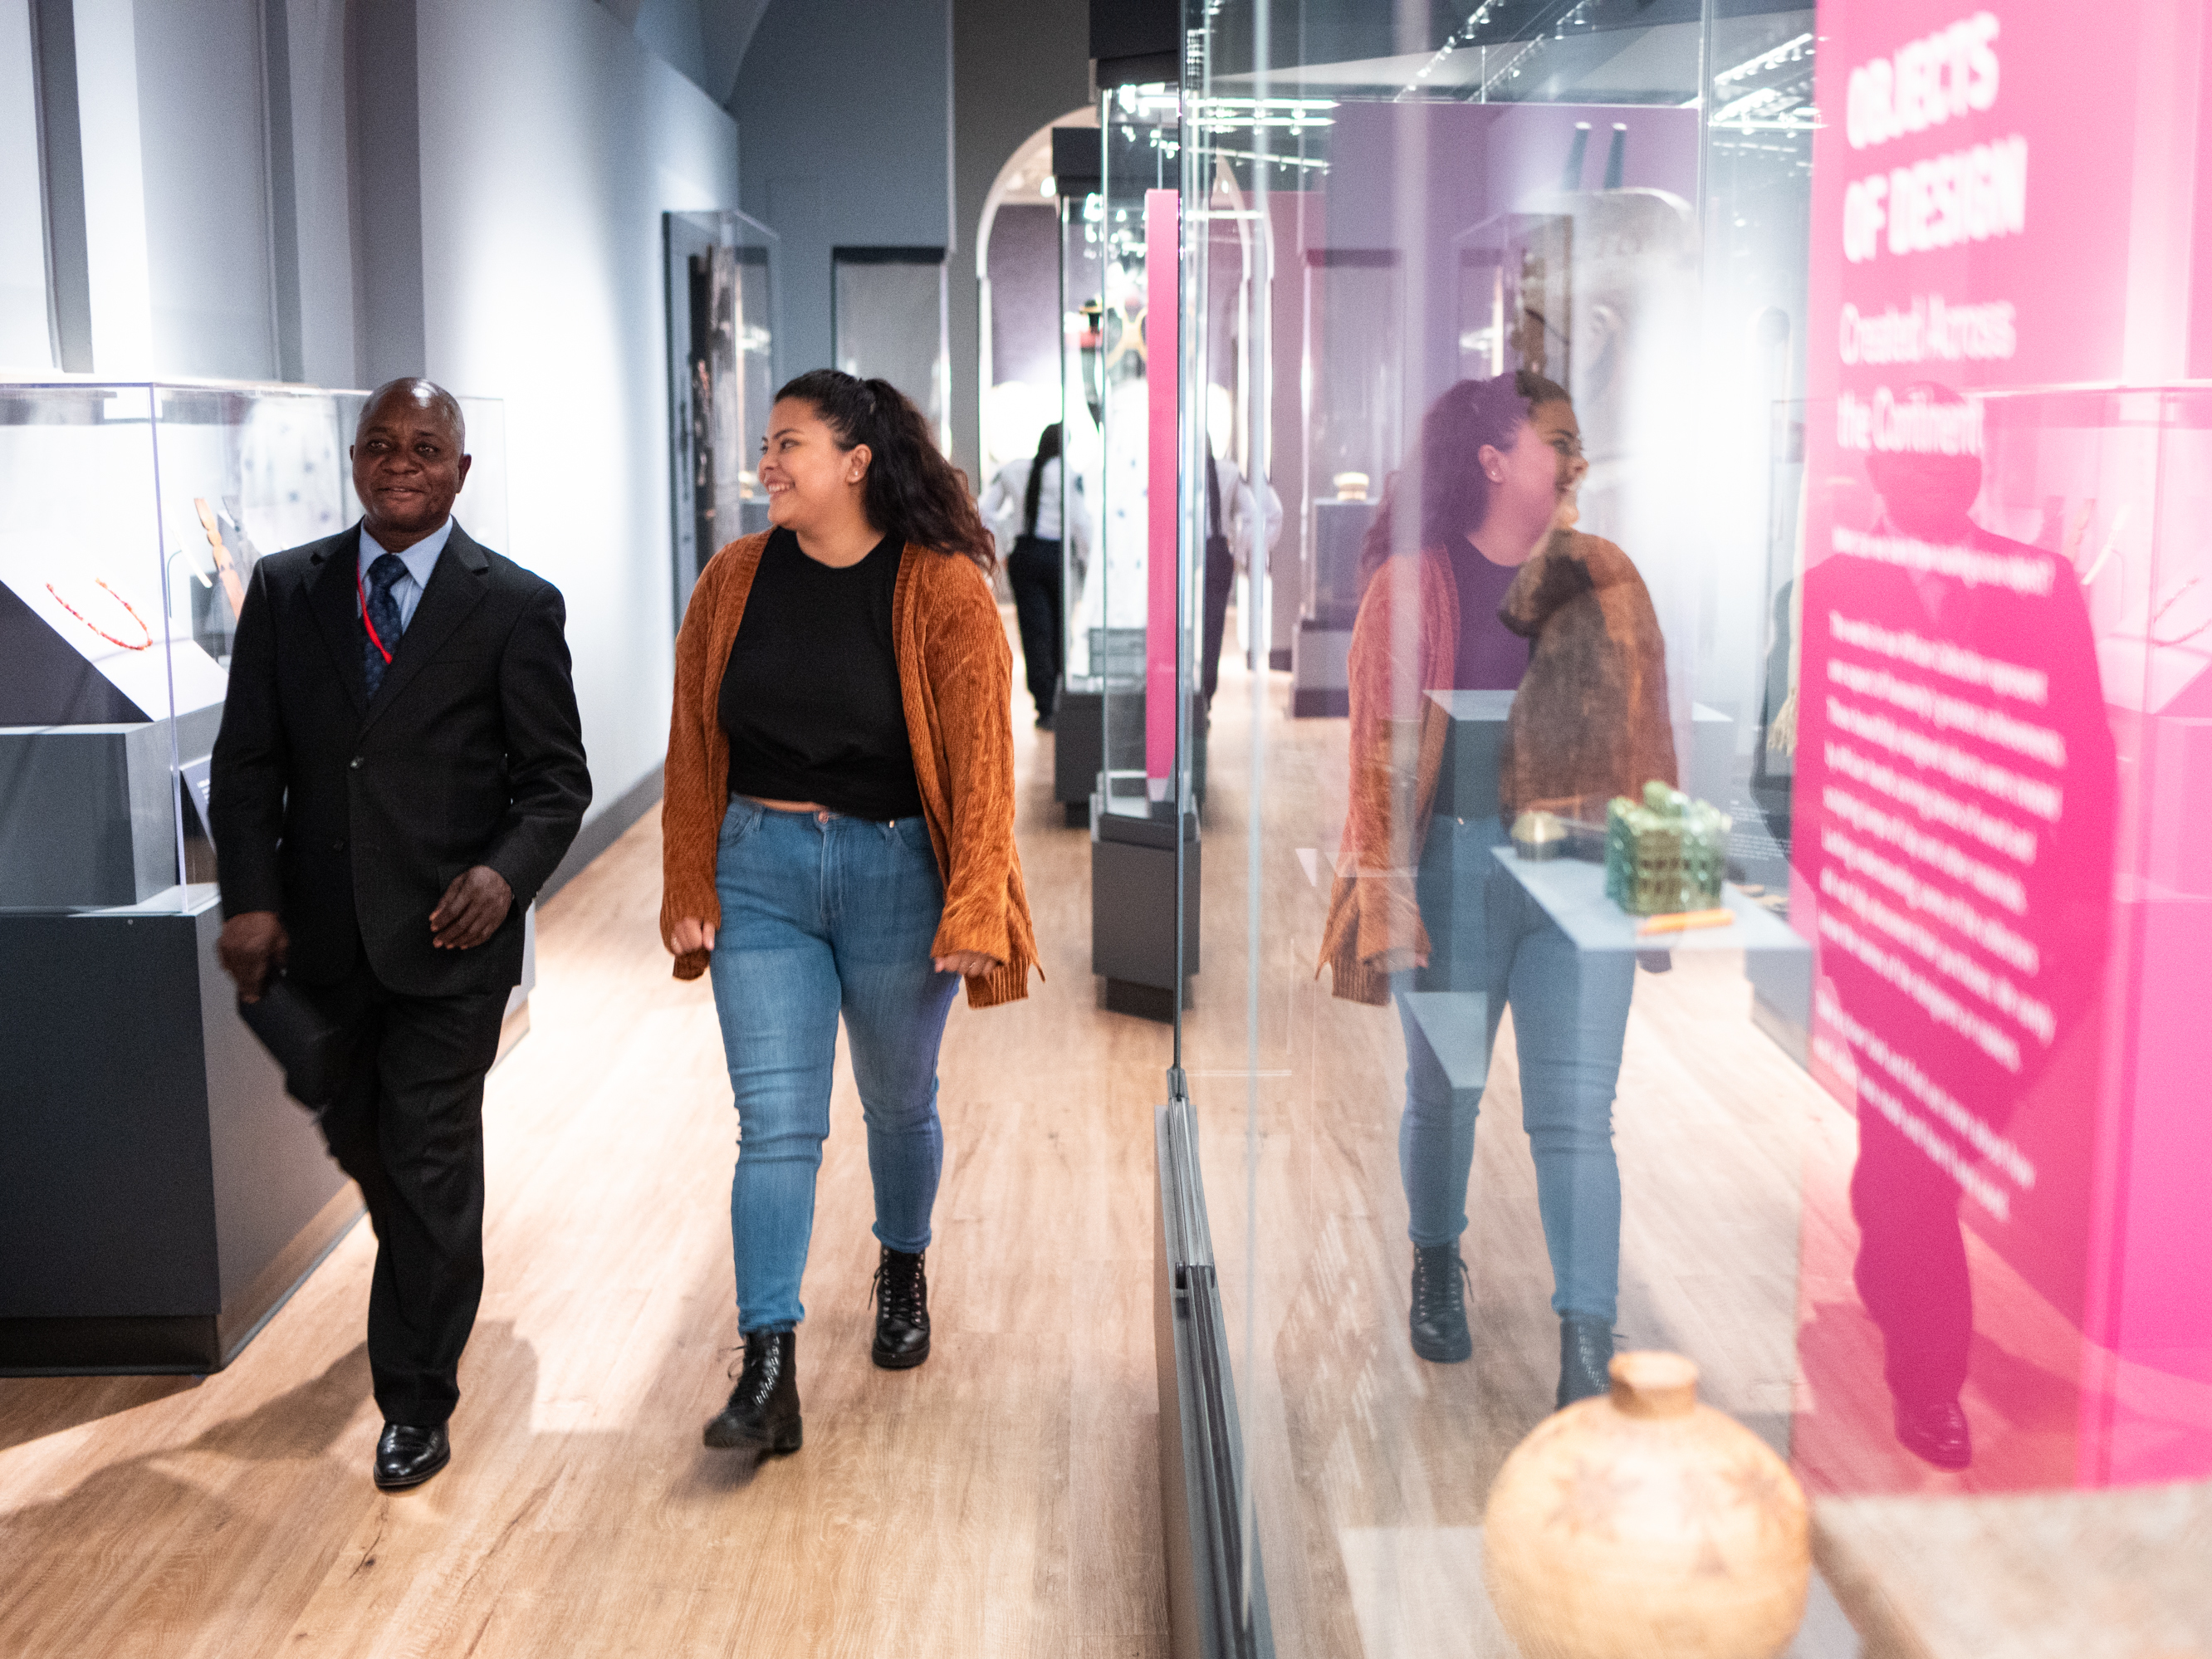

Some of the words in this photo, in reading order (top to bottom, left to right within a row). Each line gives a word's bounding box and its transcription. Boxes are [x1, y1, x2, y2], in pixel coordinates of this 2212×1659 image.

[1847, 12, 1999, 149] OBJECTS
[1843, 174, 1889, 263] OF
[1888, 133, 2028, 255] DESIGN
[1839, 295, 1926, 364] Created
[1928, 292, 2016, 360] Across
